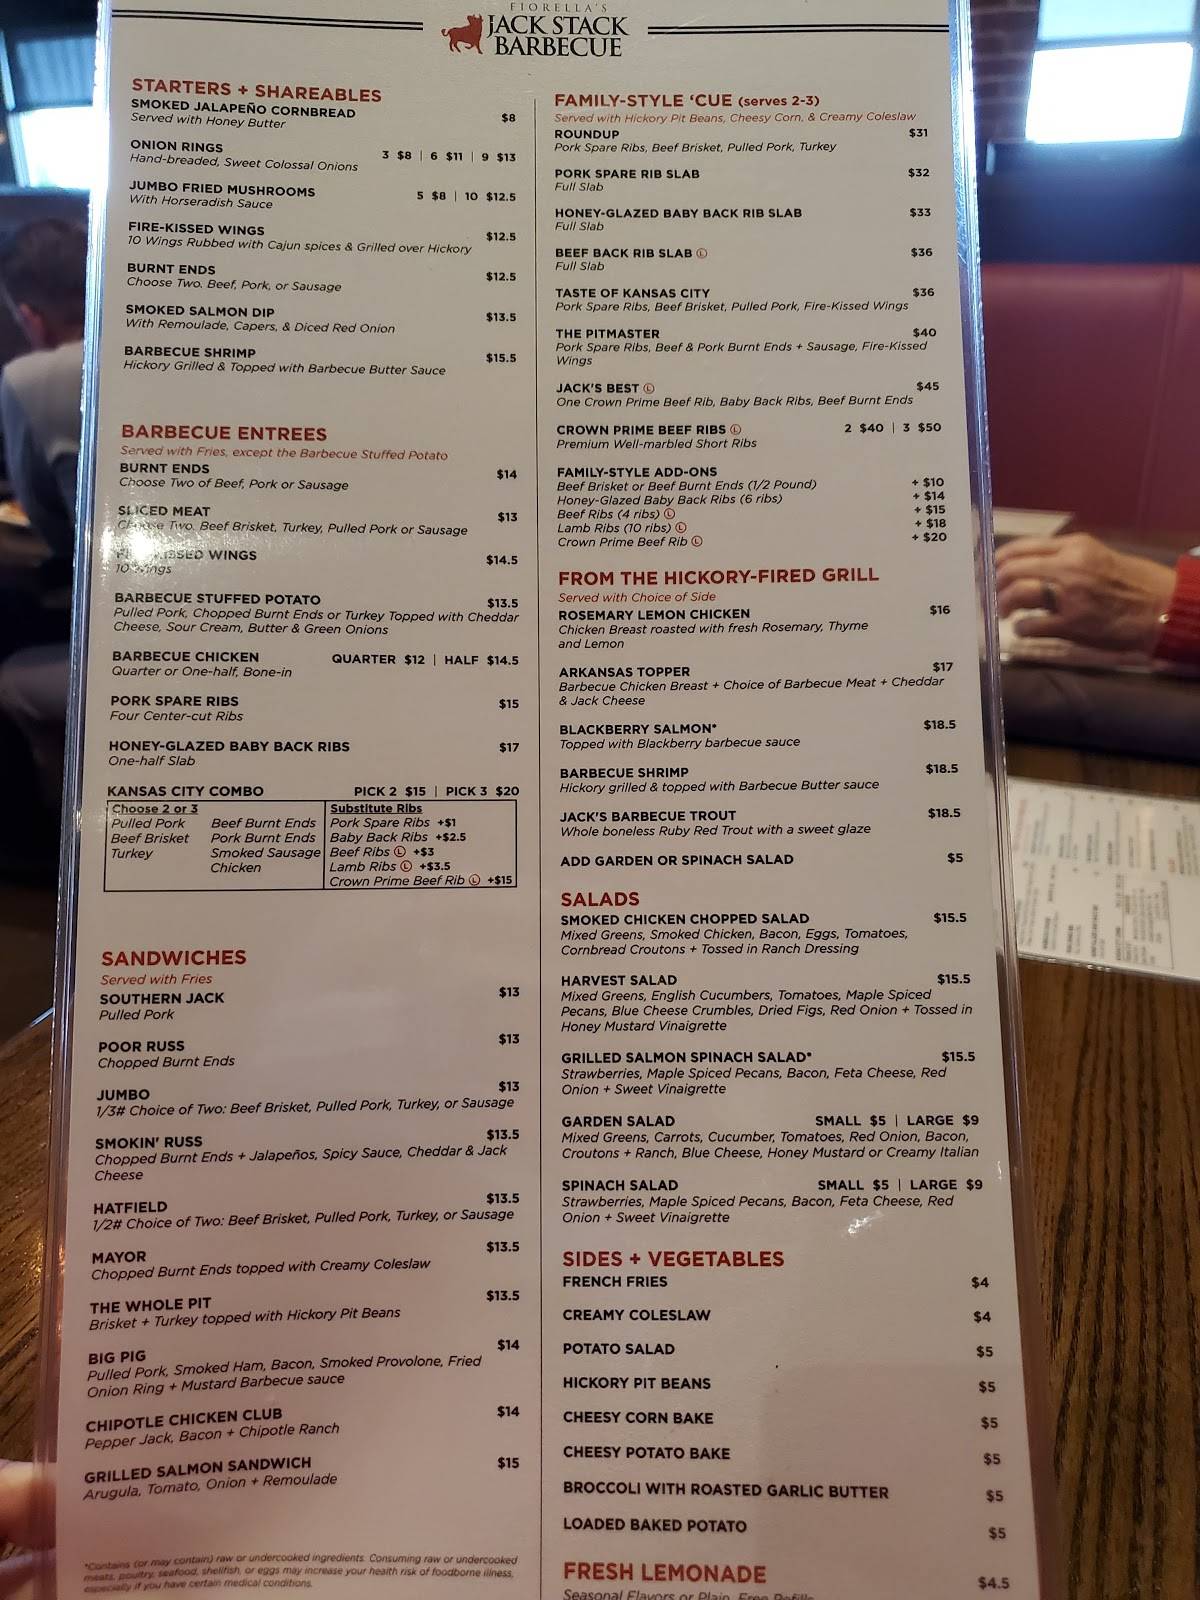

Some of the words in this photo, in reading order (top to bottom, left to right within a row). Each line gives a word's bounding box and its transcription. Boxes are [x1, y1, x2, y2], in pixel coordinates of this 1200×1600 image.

[510, 2, 608, 13] FIORELLA'S
[487, 14, 548, 38] JACK
[552, 16, 630, 36] STACK
[495, 36, 622, 57] BARBECUE
[131, 78, 232, 96] STARTERS
[255, 84, 382, 103] SHAREABLES
[554, 93, 684, 108] FAMILY-STYLE
[738, 96, 788, 108] (serves
[791, 95, 820, 107] 2-3)
[131, 98, 190, 111] SMOKED
[193, 101, 267, 115] JALAPEÑO
[270, 105, 356, 119] CORNBREAD
[130, 112, 174, 124] Served
[176, 114, 202, 125] with
[205, 115, 245, 129] Honey
[247, 117, 287, 129] Butter
[501, 112, 516, 123] $8
[554, 129, 620, 140] ROUNDUP
[908, 127, 928, 139] $31
[130, 139, 177, 151] ONION
[181, 141, 223, 153] RINGS
[554, 142, 582, 152] Pork
[584, 142, 618, 154] Spare
[620, 142, 648, 153] Ribs,
[651, 142, 680, 153] Beef
[681, 142, 723, 153] Brisket,
[727, 141, 764, 152] Pulled
[766, 141, 795, 153] Pork,
[799, 141, 838, 153] Turkey
[128, 180, 179, 192] JUMBO
[182, 182, 223, 194] FRIED
[227, 184, 316, 198] MUSHROOMS
[555, 208, 659, 219] HONEY-GLAZED
[663, 208, 699, 219] BABY
[702, 208, 739, 219] BACK
[742, 208, 765, 219] RIB
[768, 208, 803, 219] SLAB
[909, 207, 931, 218] $33
[128, 221, 214, 234] FIRE-KISSED
[217, 224, 265, 236] WINGS
[486, 231, 517, 242] $12.5
[128, 234, 142, 245] 10
[145, 235, 183, 249] Wings
[186, 237, 236, 249] Rubbed
[238, 239, 264, 250] with
[267, 240, 301, 252] Cajun
[303, 241, 342, 253] spices
[344, 242, 353, 252] &
[356, 242, 396, 253] Grilled
[398, 245, 425, 254] over
[427, 243, 473, 256] Hickory
[124, 345, 200, 358] BARBECUE
[204, 347, 256, 359] SHRIMP
[485, 352, 517, 364] $15.5
[121, 424, 231, 440] BARBECUE
[238, 426, 327, 442] ENTREES
[556, 439, 610, 449] Premium
[613, 438, 694, 449] Well-marbled
[695, 438, 729, 449] Short
[731, 437, 758, 449] Ribs
[119, 462, 168, 474] BURNT
[172, 463, 210, 474] ENDS
[496, 468, 518, 481] $14
[559, 571, 614, 586] FROM
[620, 571, 658, 586] THE
[664, 568, 816, 585] HICKORY-FIRED
[822, 567, 880, 582] GRILL
[114, 592, 193, 604] BARBECUE
[196, 592, 261, 605] STUFFED
[264, 594, 321, 606] POTATO
[487, 597, 519, 609] $13.5
[557, 592, 600, 603] Served
[602, 592, 628, 603] with
[631, 592, 672, 603] Choice
[674, 591, 689, 602] of
[690, 591, 717, 602] Side
[109, 710, 141, 721] Four
[143, 710, 213, 722] Center-cut
[215, 710, 244, 722] Ribs
[559, 724, 650, 735] BLACKBERRY
[923, 719, 957, 731] $18.5
[329, 831, 364, 845] Baby
[365, 831, 399, 843] Back
[400, 831, 429, 843] Ribs
[435, 832, 467, 843] +$2.5
[210, 846, 265, 859] Smoked
[266, 847, 322, 860] Sausage
[560, 891, 640, 907] SALADS
[560, 914, 620, 926] SMOKED
[623, 913, 686, 926] CHICKEN
[689, 913, 758, 925] CHOPPED
[761, 913, 810, 924] SALAD
[933, 912, 967, 924] $15.5
[561, 943, 627, 956] Cornbread
[629, 943, 686, 955] Croutons
[701, 943, 744, 955] Tossed
[746, 943, 758, 954] in
[761, 942, 801, 954] Ranch
[804, 942, 860, 956] Dressing
[101, 949, 247, 967] SANDWICHES
[99, 992, 182, 1006] SOUTHERN
[185, 992, 225, 1004] JACK
[498, 986, 520, 999] $13
[486, 1192, 520, 1205] $13.5
[93, 1200, 168, 1215] HATFIELD
[562, 1250, 623, 1267] SIDES
[647, 1250, 785, 1267] VEGETABLES
[91, 1265, 155, 1282] Chopped
[157, 1265, 197, 1278] Burnt
[199, 1263, 233, 1276] Ends
[236, 1261, 285, 1276] topped
[288, 1259, 316, 1273] with
[320, 1259, 371, 1273] Creamy
[373, 1257, 432, 1270] Coleslaw
[562, 1275, 622, 1288] FRENCH
[626, 1275, 668, 1288] FRIES
[971, 1275, 990, 1289] $4
[89, 1301, 121, 1315] THE
[124, 1298, 184, 1313] WHOLE
[188, 1296, 212, 1310] PIT
[563, 1376, 630, 1389] HICKORY
[633, 1377, 657, 1390] PIT
[660, 1377, 711, 1390] BEANS
[978, 1380, 996, 1394] $5
[496, 1405, 520, 1419] $14
[85, 1415, 164, 1433] CHIPOTLE
[168, 1409, 238, 1427] CHICKEN
[242, 1407, 283, 1422] CLUB
[563, 1480, 641, 1495] BROCCOLI
[645, 1482, 686, 1496] WITH
[690, 1482, 762, 1497] ROASTED
[766, 1484, 824, 1498] GARLIC
[828, 1485, 889, 1500] BUTTER
[985, 1489, 1004, 1503] $5
[563, 1561, 634, 1581] FRESH
[641, 1562, 767, 1584] LEMONADE
[977, 1575, 1010, 1591] $4.5
